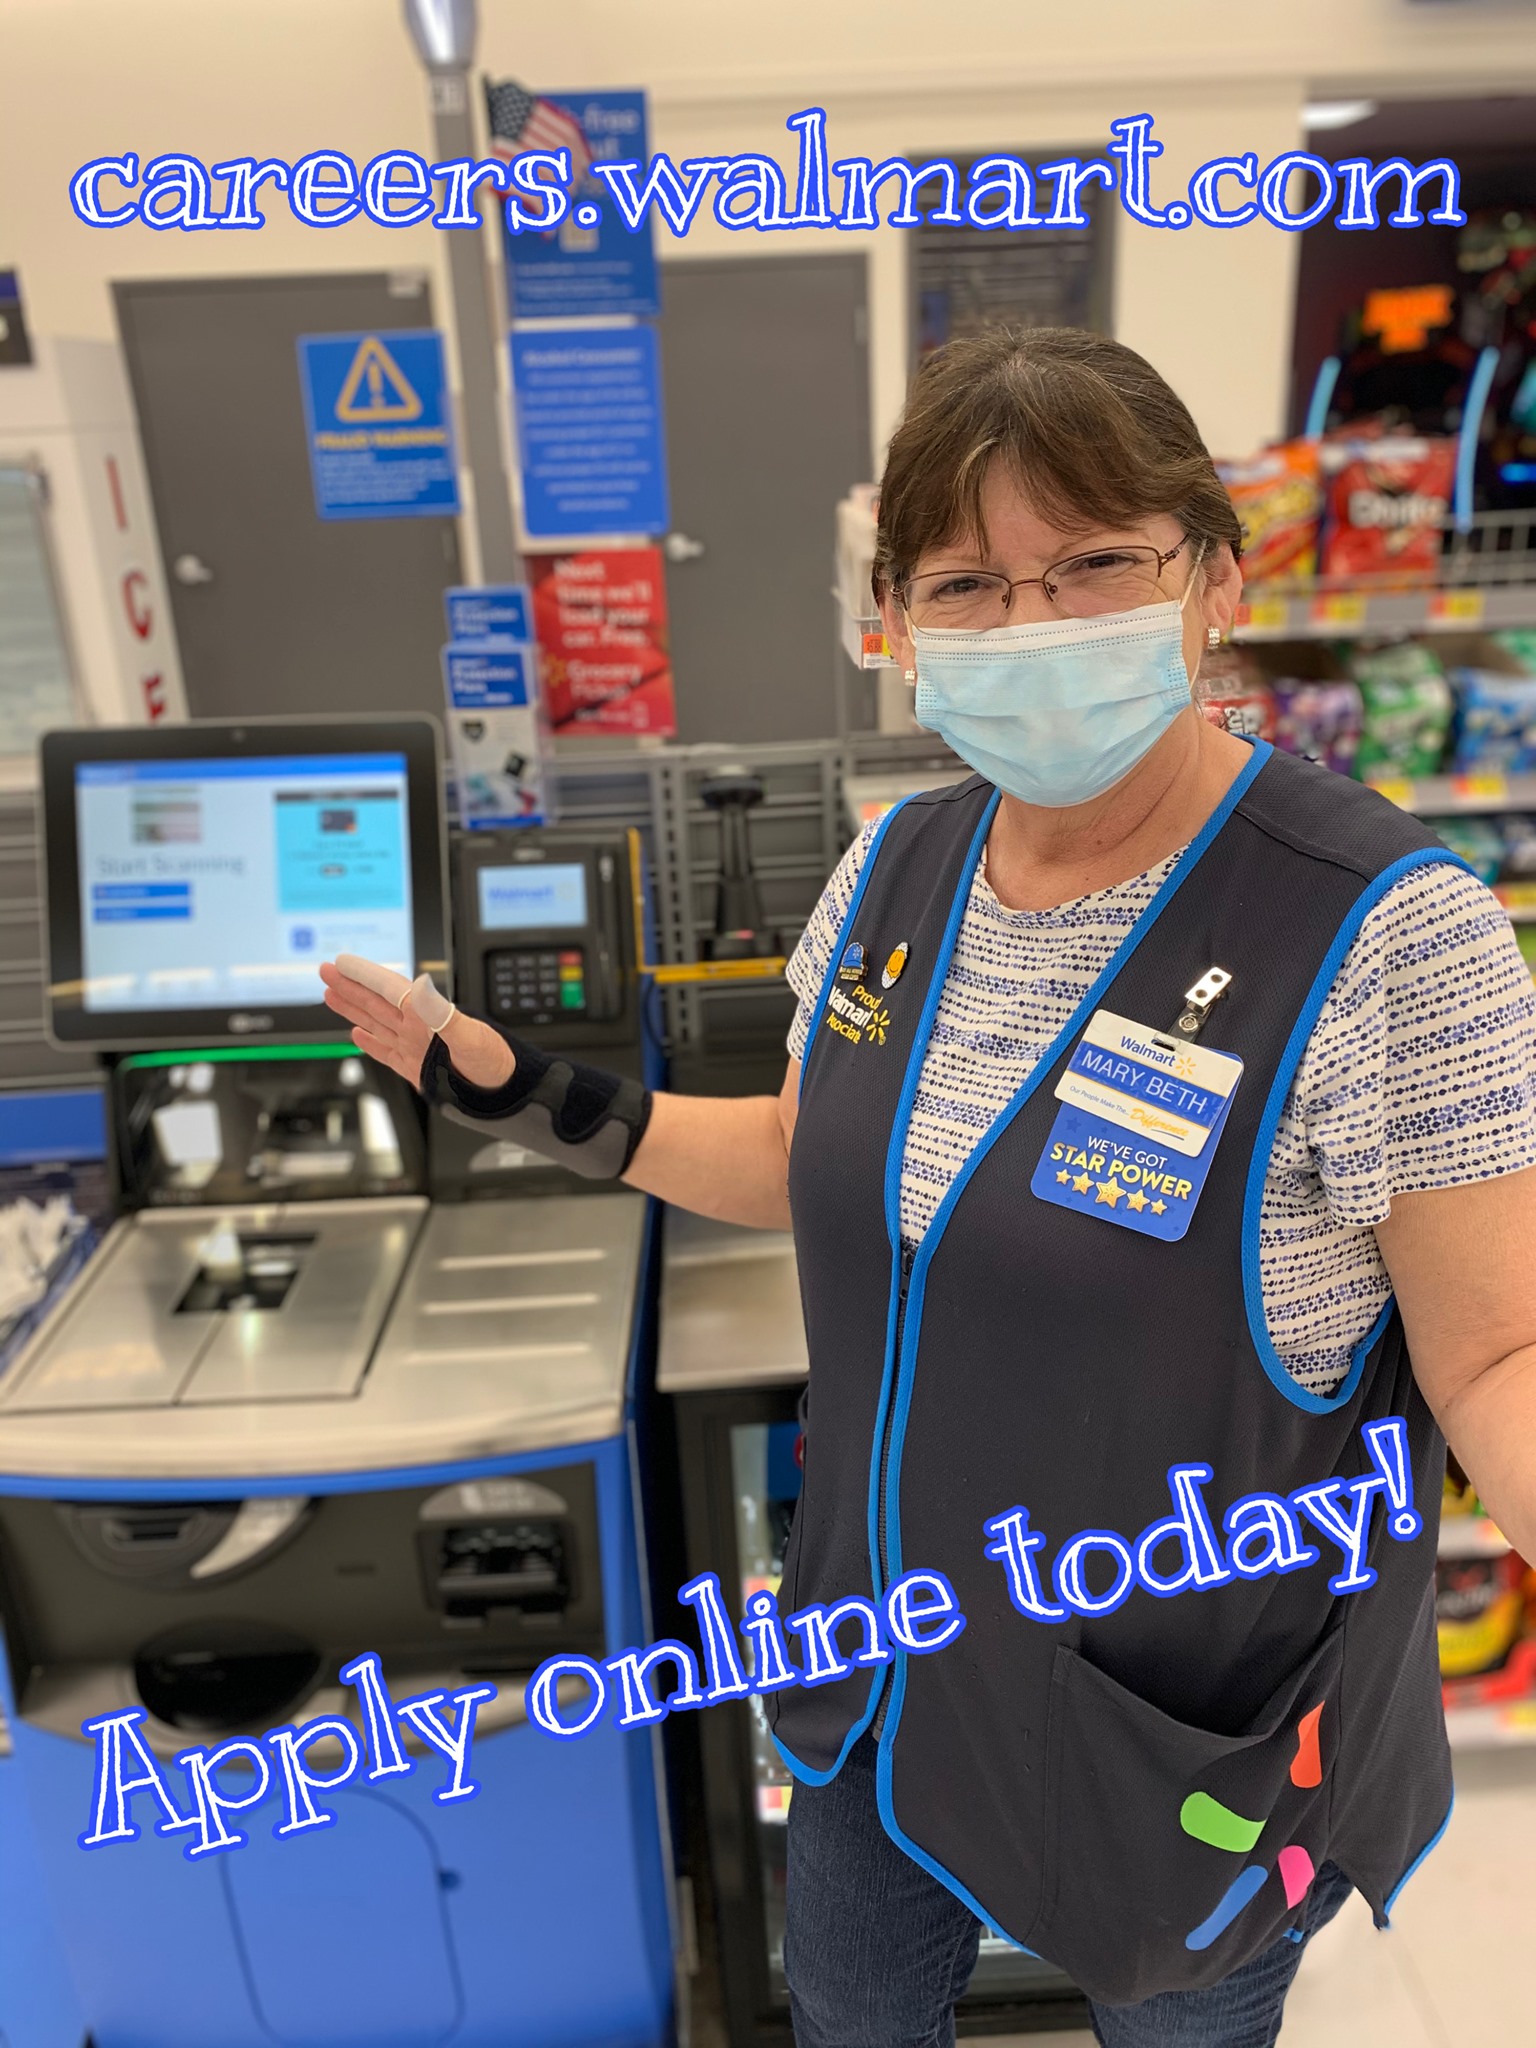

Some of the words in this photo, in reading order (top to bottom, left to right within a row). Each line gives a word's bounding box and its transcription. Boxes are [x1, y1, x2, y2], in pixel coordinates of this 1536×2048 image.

[1120, 1035, 1177, 1067] Walmart
[1069, 1085, 1081, 1094] Our
[1081, 1090, 1102, 1101] People
[1100, 1098, 1115, 1109] Make
[1081, 1050, 1145, 1087] MARY
[1145, 1076, 1208, 1115] BETH
[1130, 1108, 1189, 1137] Difference
[1088, 1135, 1133, 1160] WE'VE
[1134, 1150, 1168, 1170] GOT
[1050, 1142, 1106, 1173] STAR
[1107, 1159, 1193, 1200] POWER
